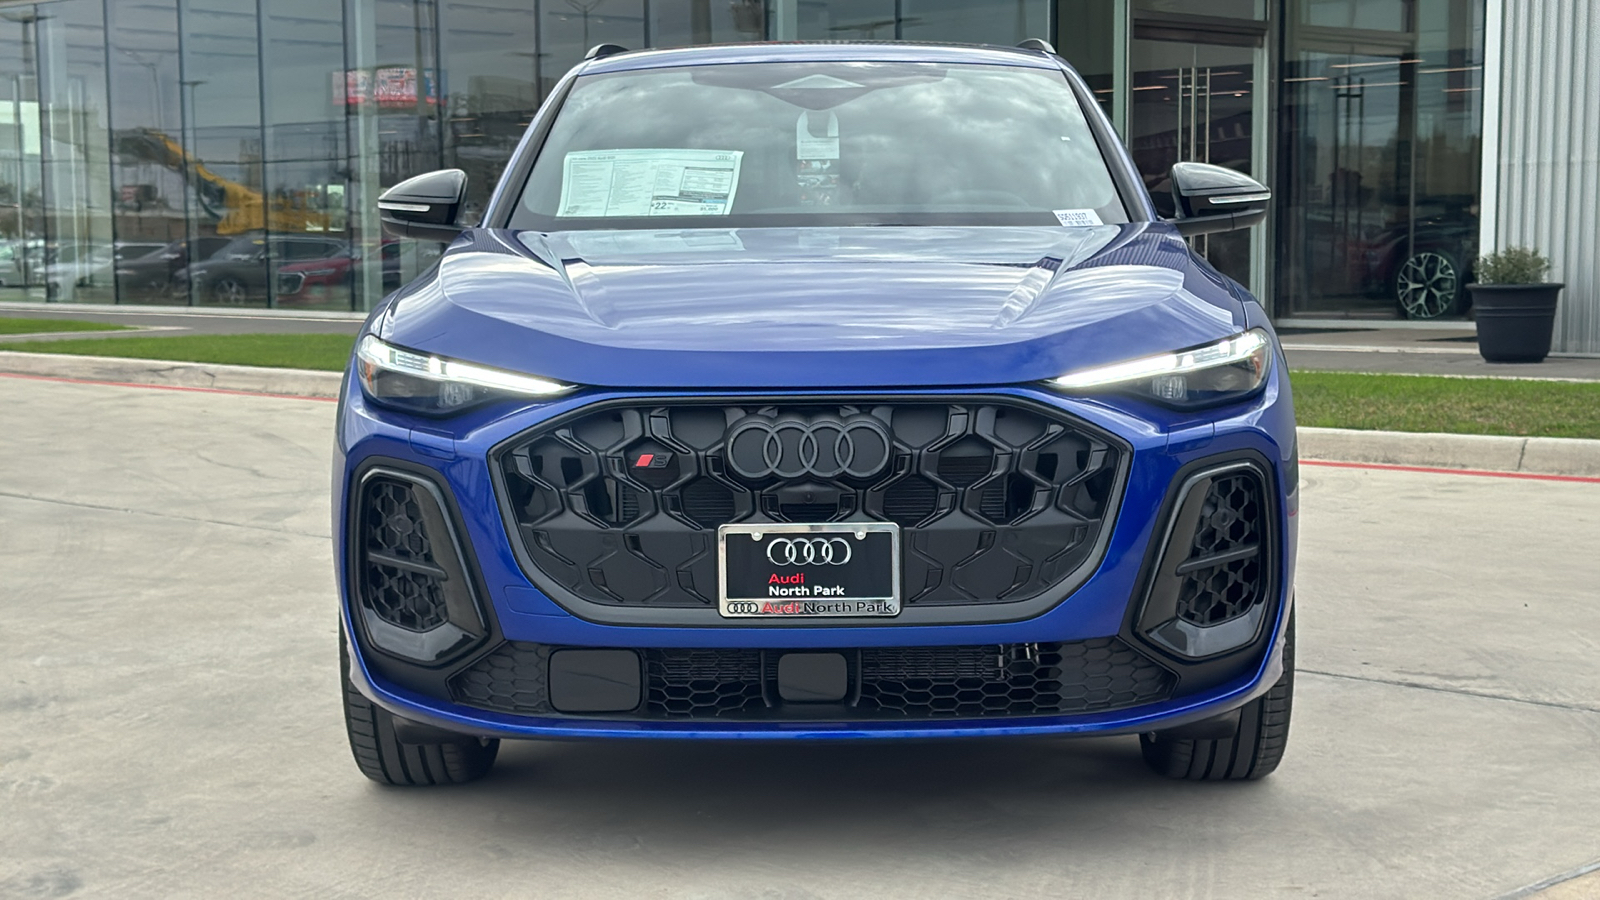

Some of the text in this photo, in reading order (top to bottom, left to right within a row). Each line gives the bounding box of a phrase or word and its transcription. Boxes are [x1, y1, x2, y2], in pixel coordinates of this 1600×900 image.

[655, 202, 667, 210] 22
[654, 455, 668, 466] S
[768, 573, 805, 584] Audi
[768, 585, 845, 597] North Park
[761, 602, 892, 614] Audi North Park
